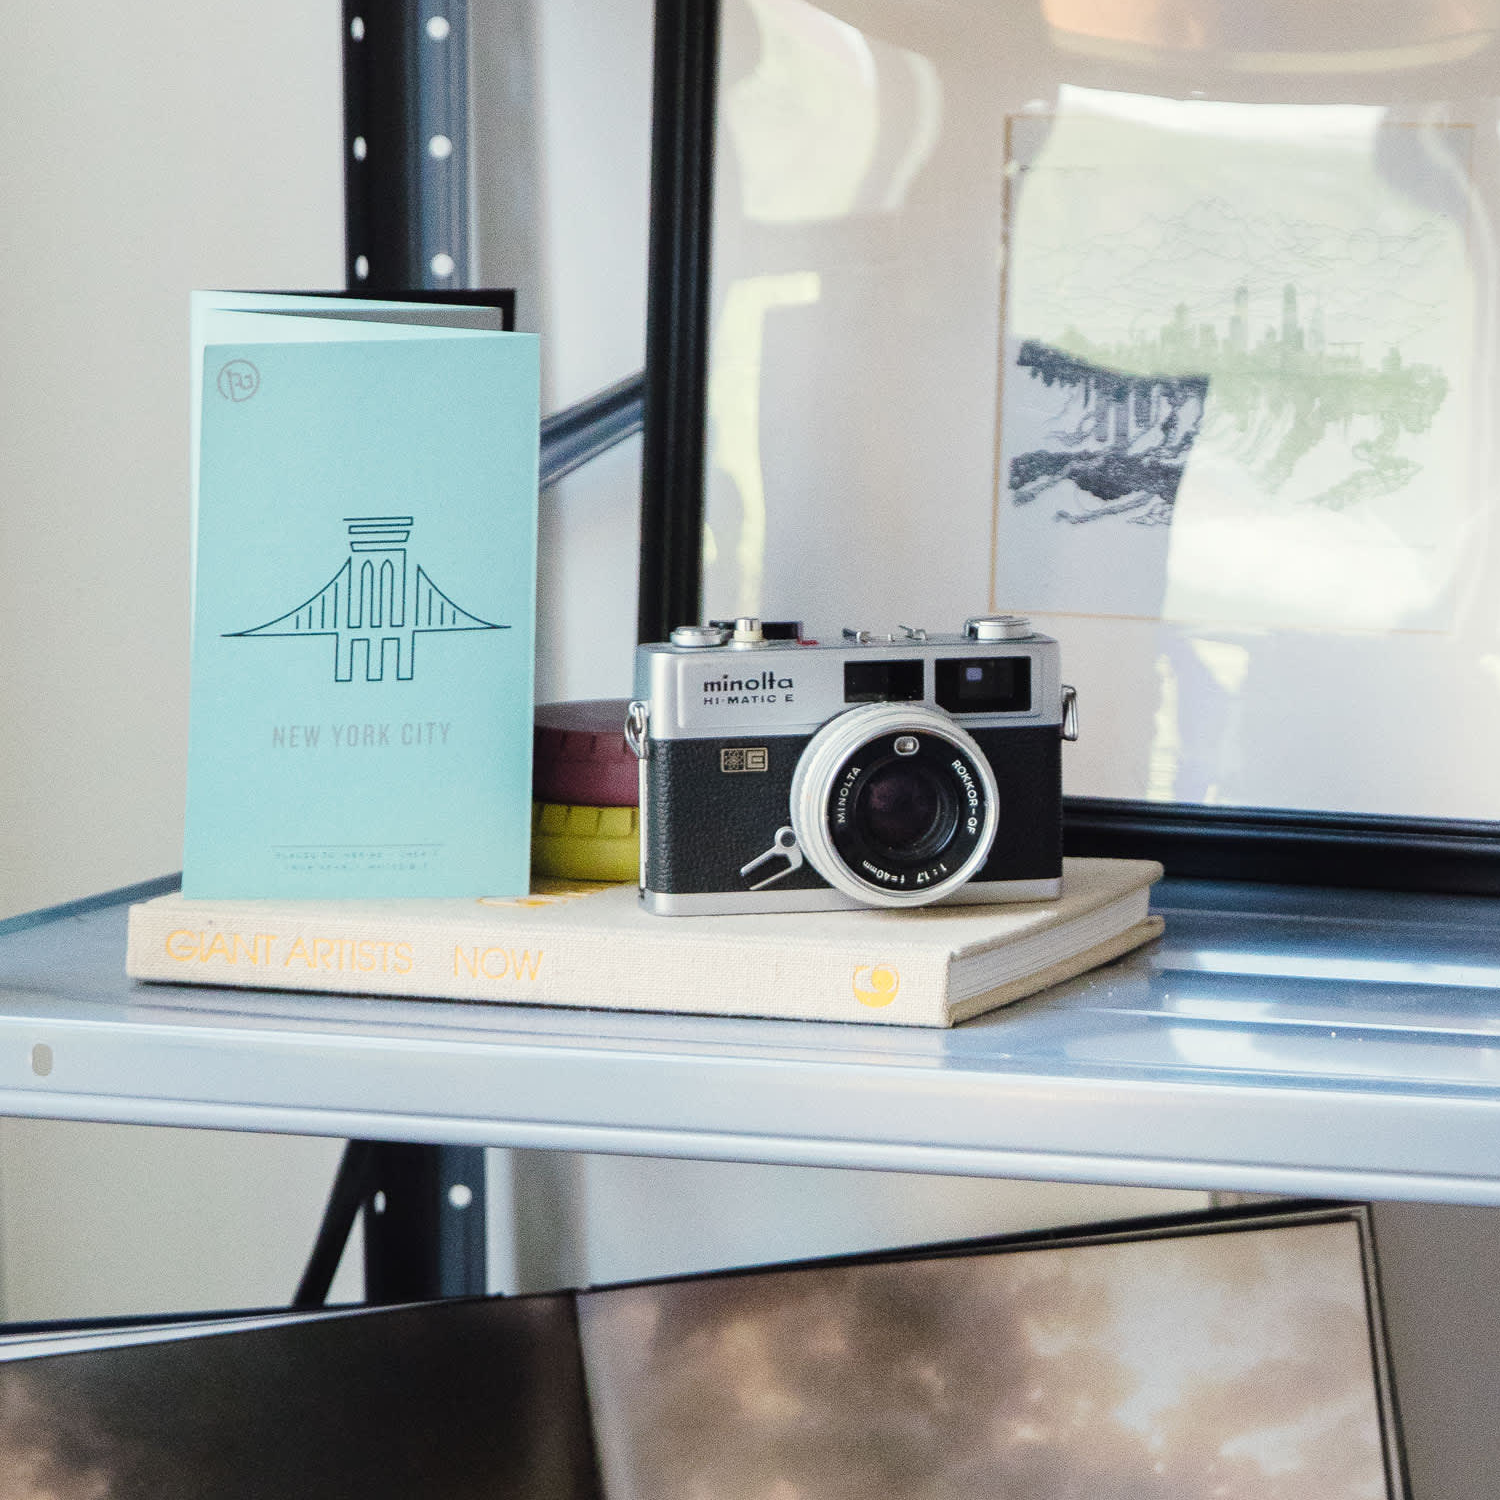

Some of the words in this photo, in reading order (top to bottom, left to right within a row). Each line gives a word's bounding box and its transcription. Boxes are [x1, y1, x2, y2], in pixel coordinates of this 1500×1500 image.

[703, 671, 794, 692] minolta
[703, 694, 778, 706] HI-MATIC
[784, 693, 794, 703] E
[272, 725, 321, 749] NEW
[333, 723, 391, 748] YORK
[401, 721, 451, 746] CITY
[836, 766, 862, 825] MINOLTA
[165, 929, 279, 966] GIANT
[283, 937, 414, 975] ARTISTS
[454, 945, 544, 982] NOW
